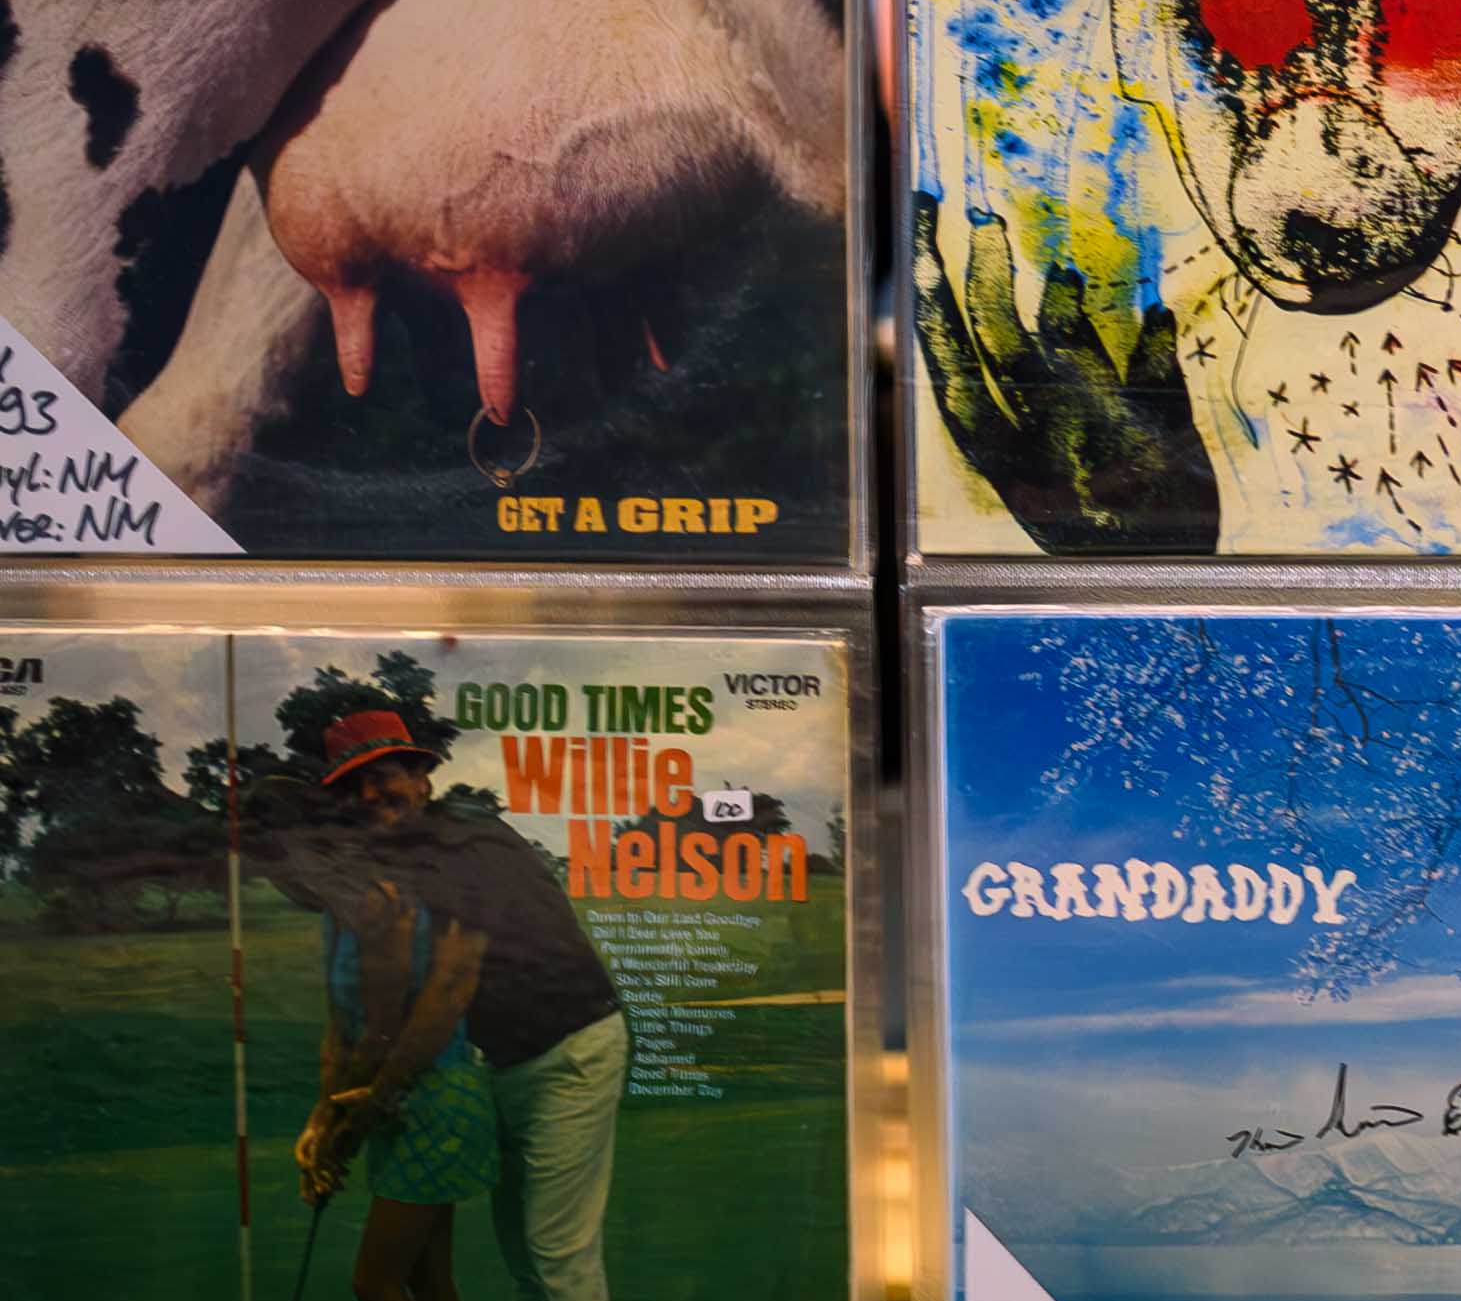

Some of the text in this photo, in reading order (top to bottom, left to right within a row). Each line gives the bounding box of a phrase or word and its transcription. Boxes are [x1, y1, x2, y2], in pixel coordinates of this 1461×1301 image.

[58, 450, 140, 499] NM
[75, 496, 162, 547] NM
[496, 495, 779, 534] GET A GRIP
[454, 681, 715, 736] GOOD TIMES
[722, 673, 822, 697] VICTOR
[501, 735, 694, 819] Willie
[567, 818, 809, 903] Nelson
[961, 858, 1357, 926] GRANDADDY
